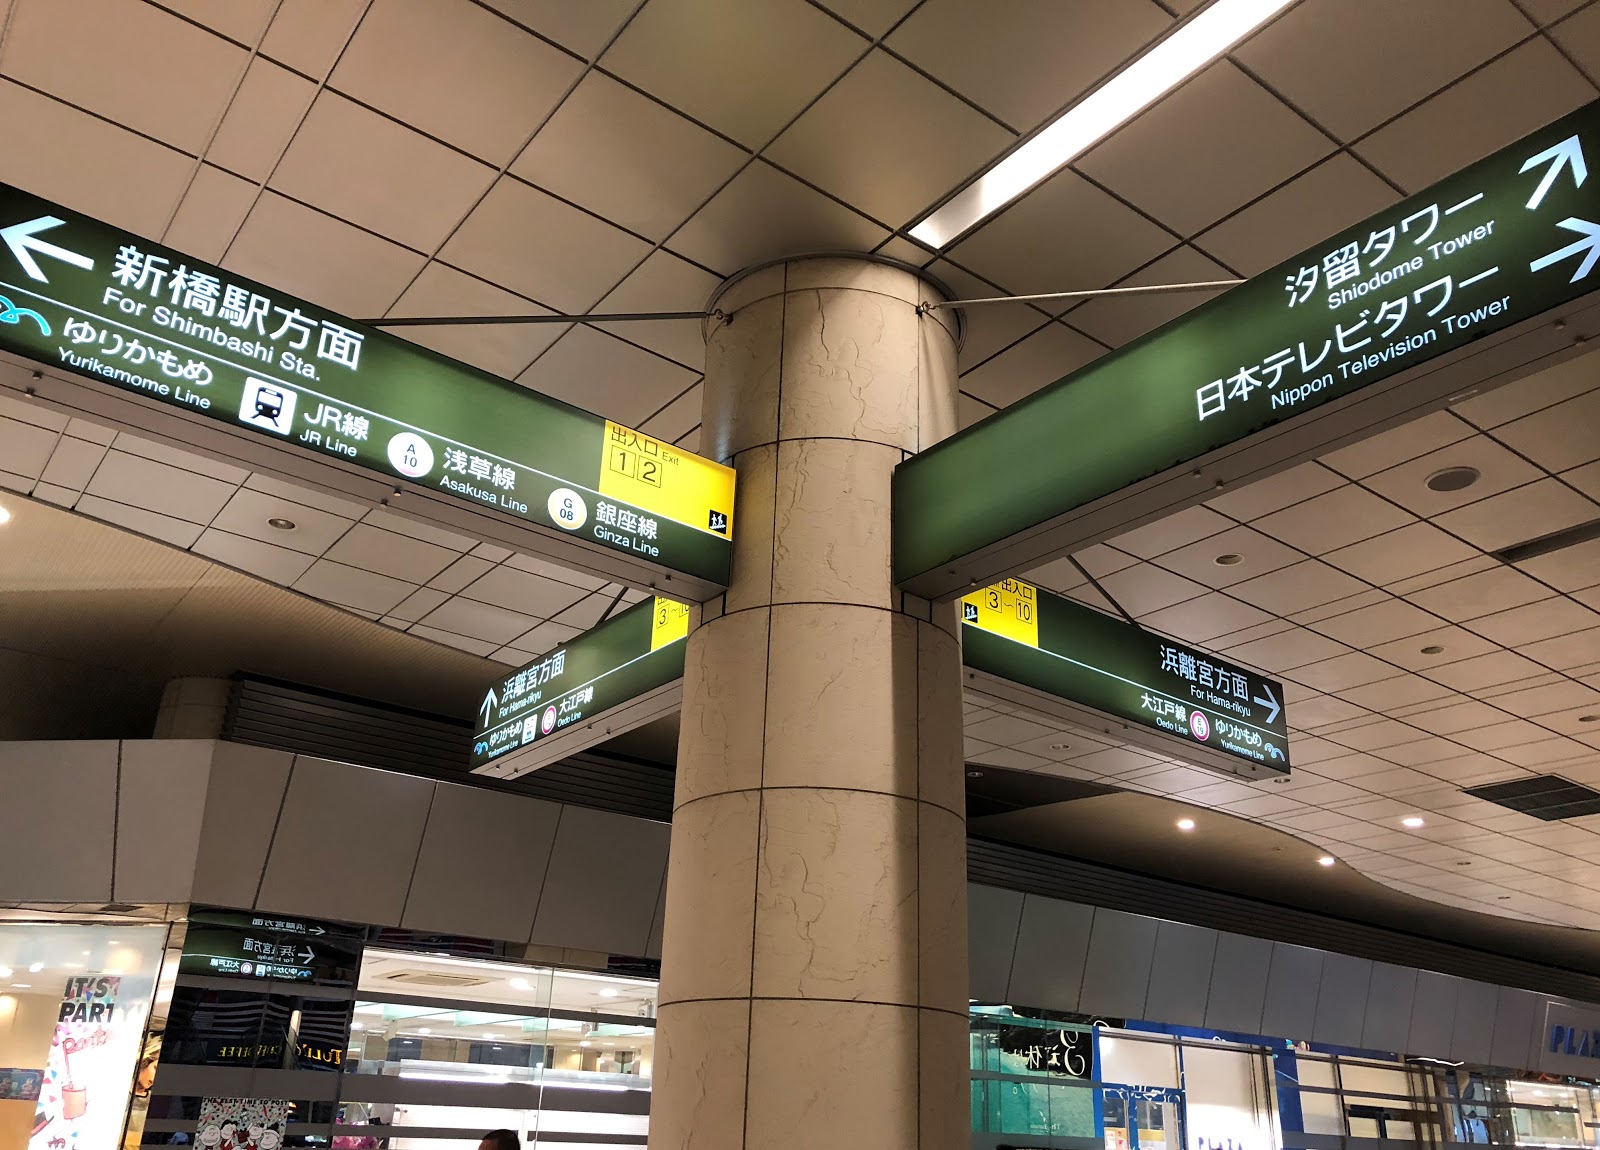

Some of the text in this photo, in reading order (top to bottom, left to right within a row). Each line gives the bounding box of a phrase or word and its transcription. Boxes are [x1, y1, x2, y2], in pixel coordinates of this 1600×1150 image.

[1285, 192, 1484, 308] 汐留タワー
[1327, 219, 1496, 310] Shiodome Tower
[111, 244, 365, 371] 新橋駅方面
[102, 286, 321, 381] For Shimbashi Sta.
[1196, 266, 1499, 421] 日本テレビタワー
[63, 318, 213, 386] ゆりかもめ
[1270, 295, 1511, 410] Nippon Television Tower
[58, 347, 211, 410] Yurikamome Line
[304, 403, 370, 441] JR線
[300, 429, 357, 457] JR Line
[406, 443, 416, 455] A
[611, 426, 679, 466] 出入口 Exit
[403, 455, 418, 468] 10
[442, 447, 516, 491] 浅草線
[618, 452, 656, 483] 1 2
[439, 476, 528, 514] Asakusa Line
[563, 498, 573, 508] G
[559, 509, 574, 521] 08
[596, 501, 658, 540] 銀座線
[593, 525, 660, 557] Ginza Line
[659, 608, 667, 625] 3
[989, 591, 999, 608] 3
[1017, 602, 1031, 621] 10
[501, 649, 567, 704] 浜離宮方面
[1160, 645, 1249, 702] 浜離宮方面
[499, 706, 509, 719] For
[559, 686, 594, 716] 大江戸線
[571, 711, 582, 723] Line
[1140, 692, 1187, 722] 大江戸線
[1190, 684, 1251, 718] For Hama-rikyu
[1156, 717, 1189, 736] Oedo Line
[1215, 718, 1262, 748] ゆりかもめ
[1252, 749, 1265, 761] Line
